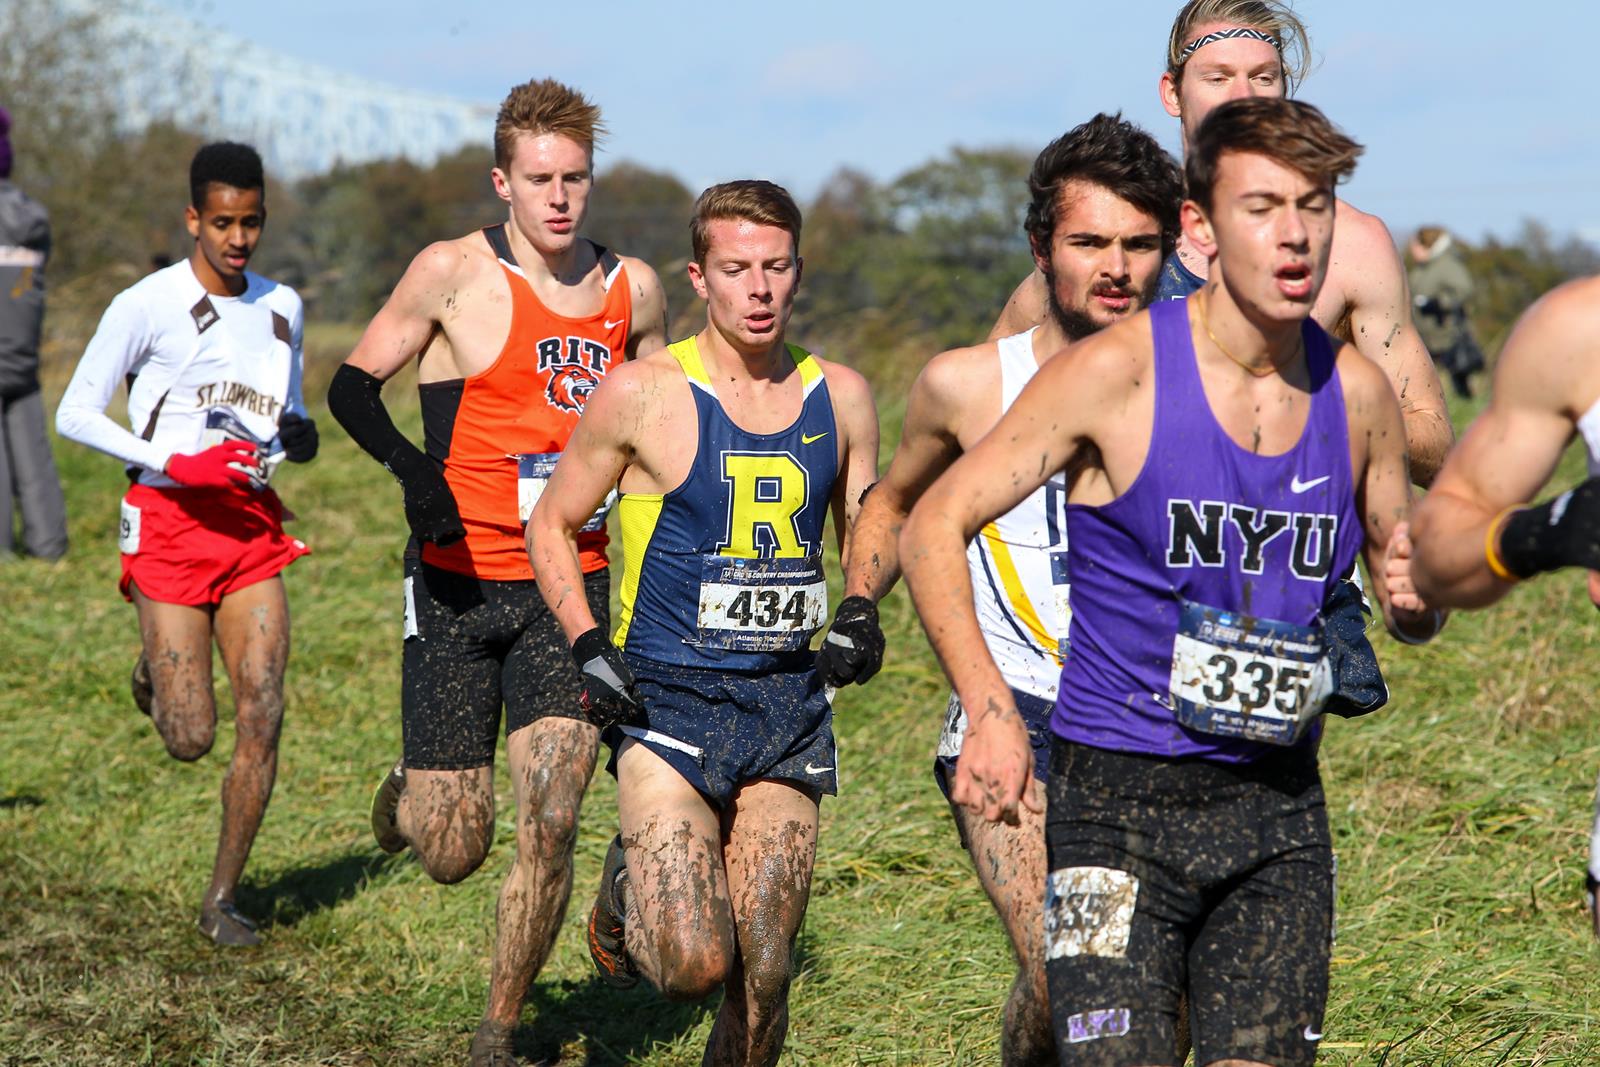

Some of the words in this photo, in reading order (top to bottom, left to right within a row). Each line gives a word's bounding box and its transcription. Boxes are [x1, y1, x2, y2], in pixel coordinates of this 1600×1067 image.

[536, 336, 612, 375] RIT
[714, 450, 810, 559] R
[1166, 499, 1338, 581] NYU
[726, 590, 807, 628] 434
[1202, 654, 1310, 715] 335
